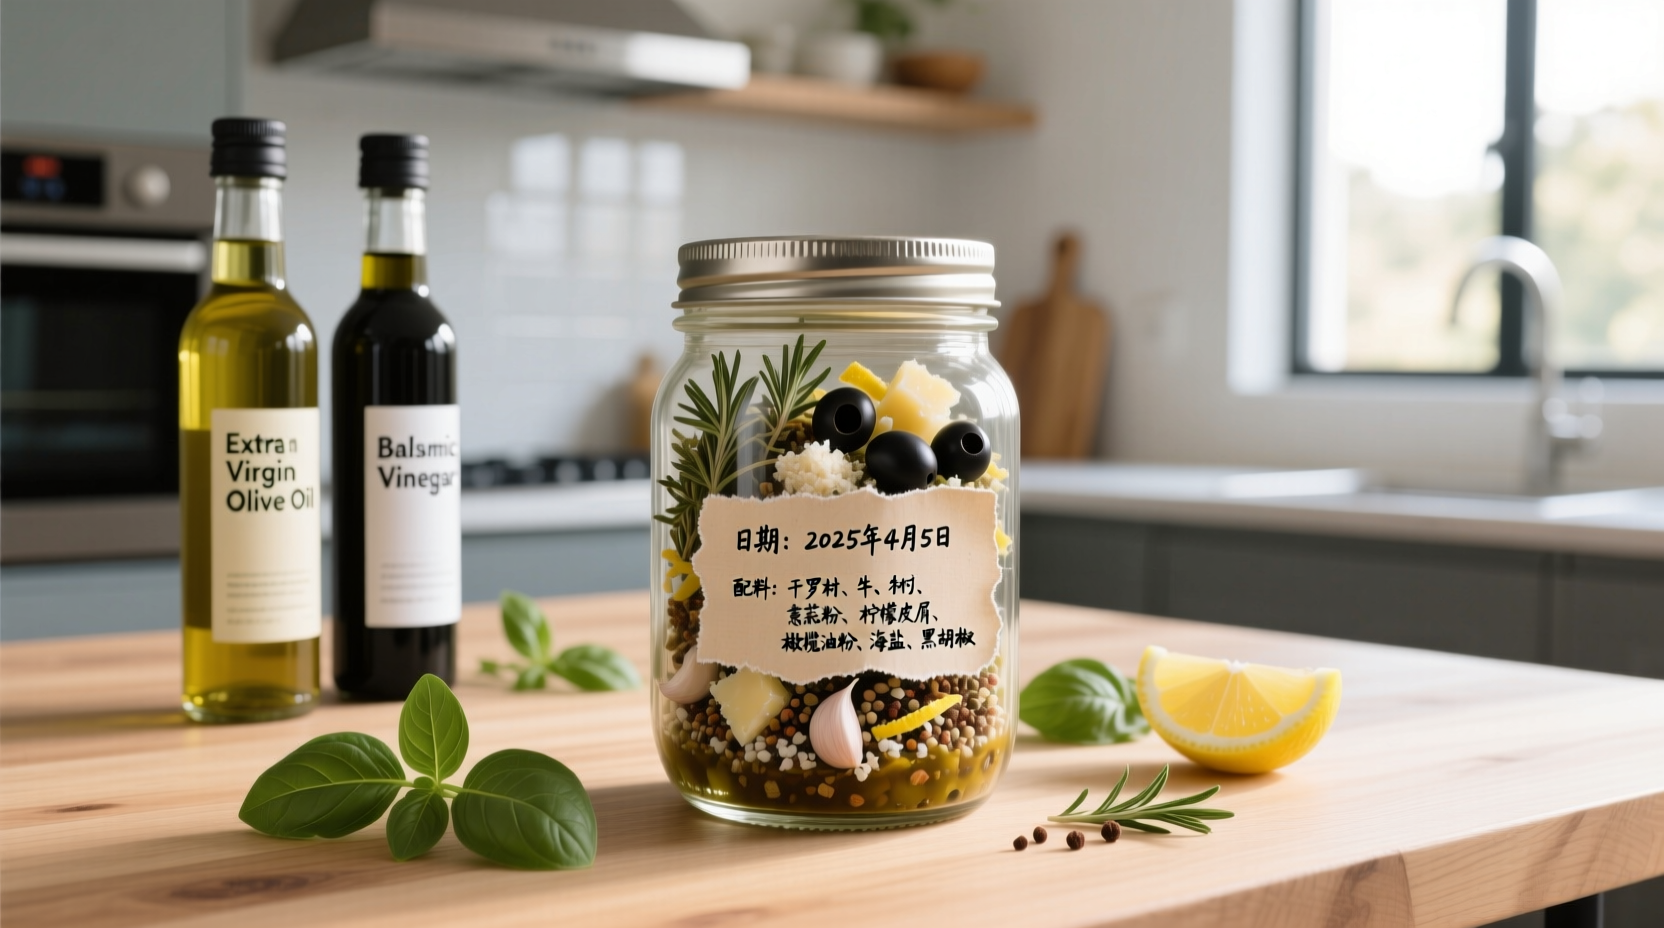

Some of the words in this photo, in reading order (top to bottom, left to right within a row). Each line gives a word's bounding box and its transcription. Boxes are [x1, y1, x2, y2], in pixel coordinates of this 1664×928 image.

[225, 432, 285, 455] Extra
[225, 459, 296, 489] Virgin
[377, 465, 457, 496] Vinegar
[225, 488, 286, 513] Olive
[290, 486, 315, 511] Oil
